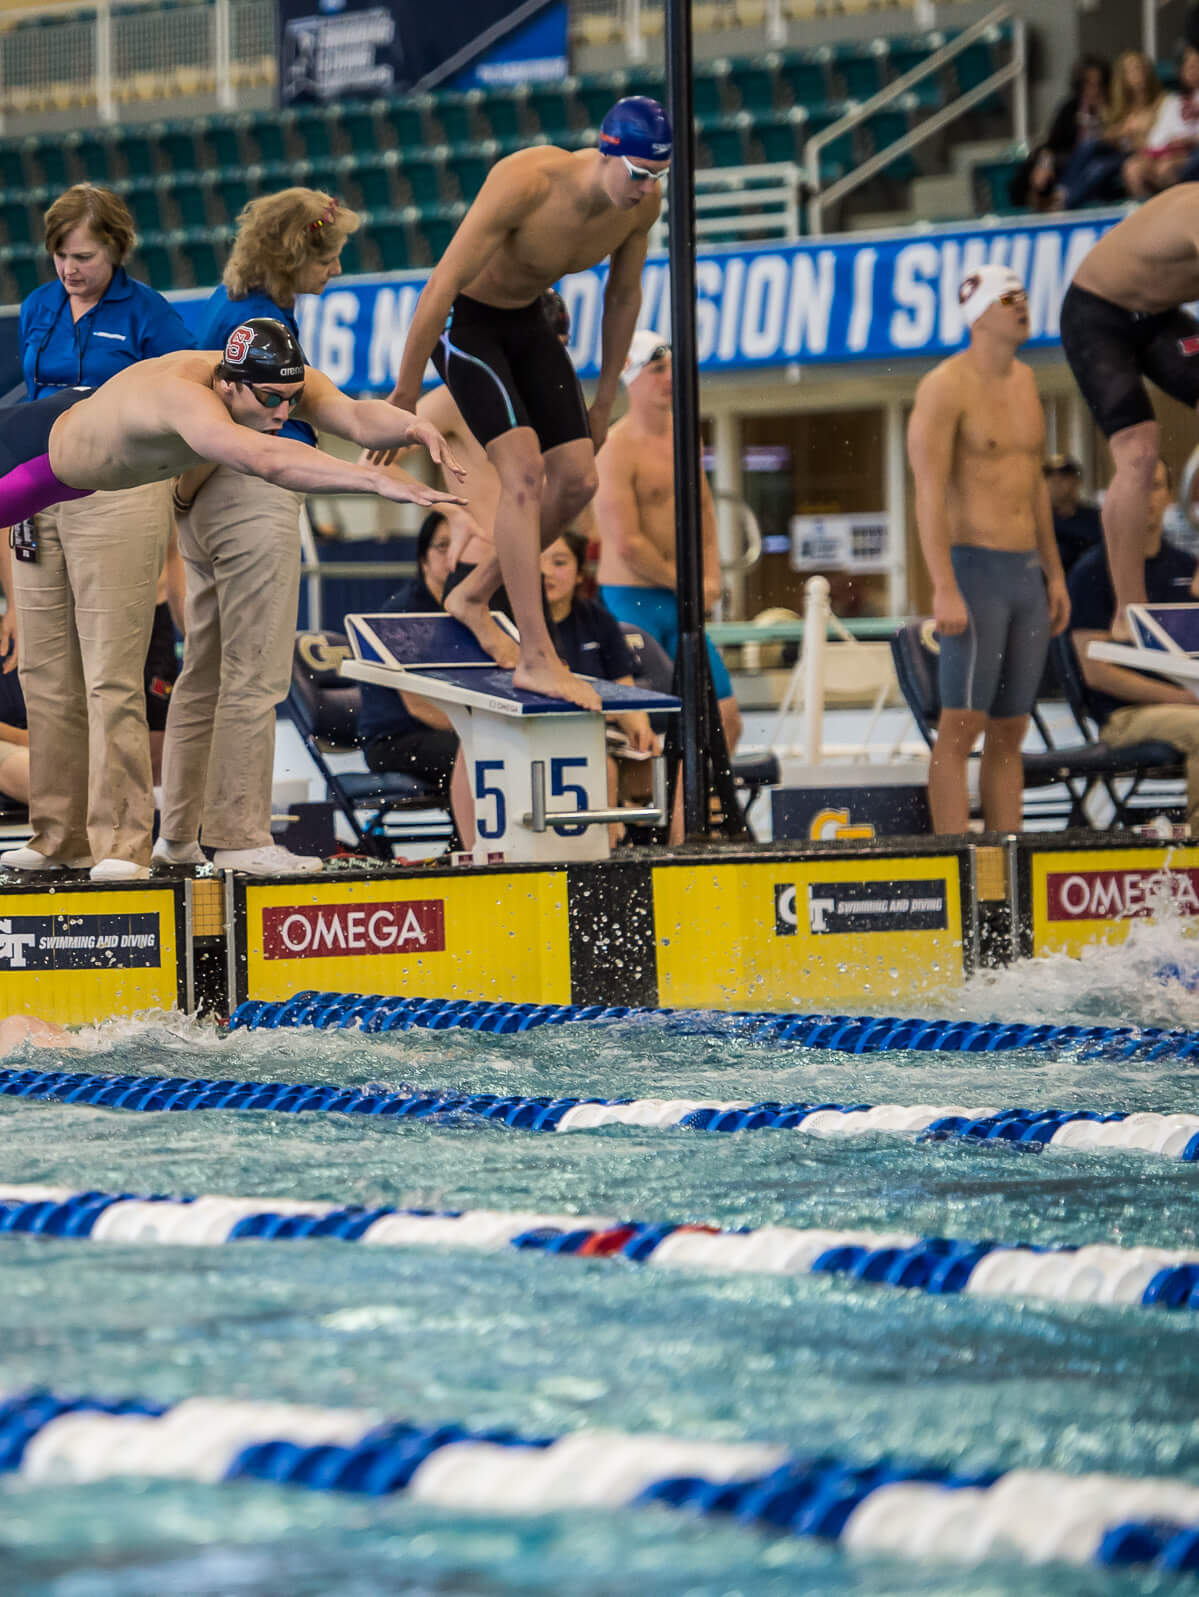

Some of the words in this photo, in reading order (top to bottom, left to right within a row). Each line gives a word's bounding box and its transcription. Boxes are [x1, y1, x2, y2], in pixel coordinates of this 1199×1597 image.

[296, 291, 360, 387] 16
[846, 247, 878, 352] I
[475, 760, 506, 839] 5
[550, 757, 589, 837] 5
[282, 907, 428, 952] OMEGA
[889, 898, 910, 913] AND
[38, 936, 96, 950] SWIMMING
[96, 934, 118, 949] AND
[120, 933, 156, 948] DIVING
